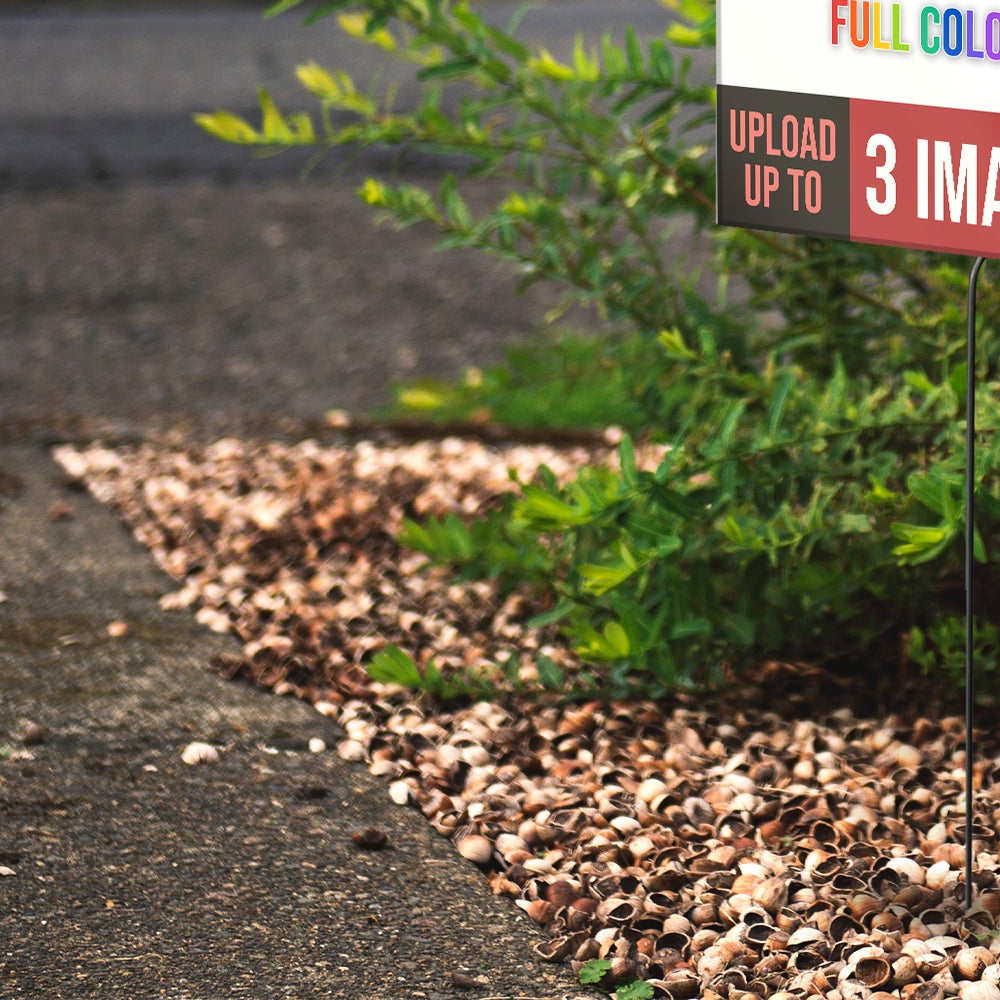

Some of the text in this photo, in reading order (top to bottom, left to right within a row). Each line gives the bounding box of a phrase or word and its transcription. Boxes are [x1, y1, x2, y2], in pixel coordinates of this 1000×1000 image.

[729, 109, 836, 163] UPLOAD
[744, 164, 824, 214] UP TO
[865, 133, 897, 216] 3
